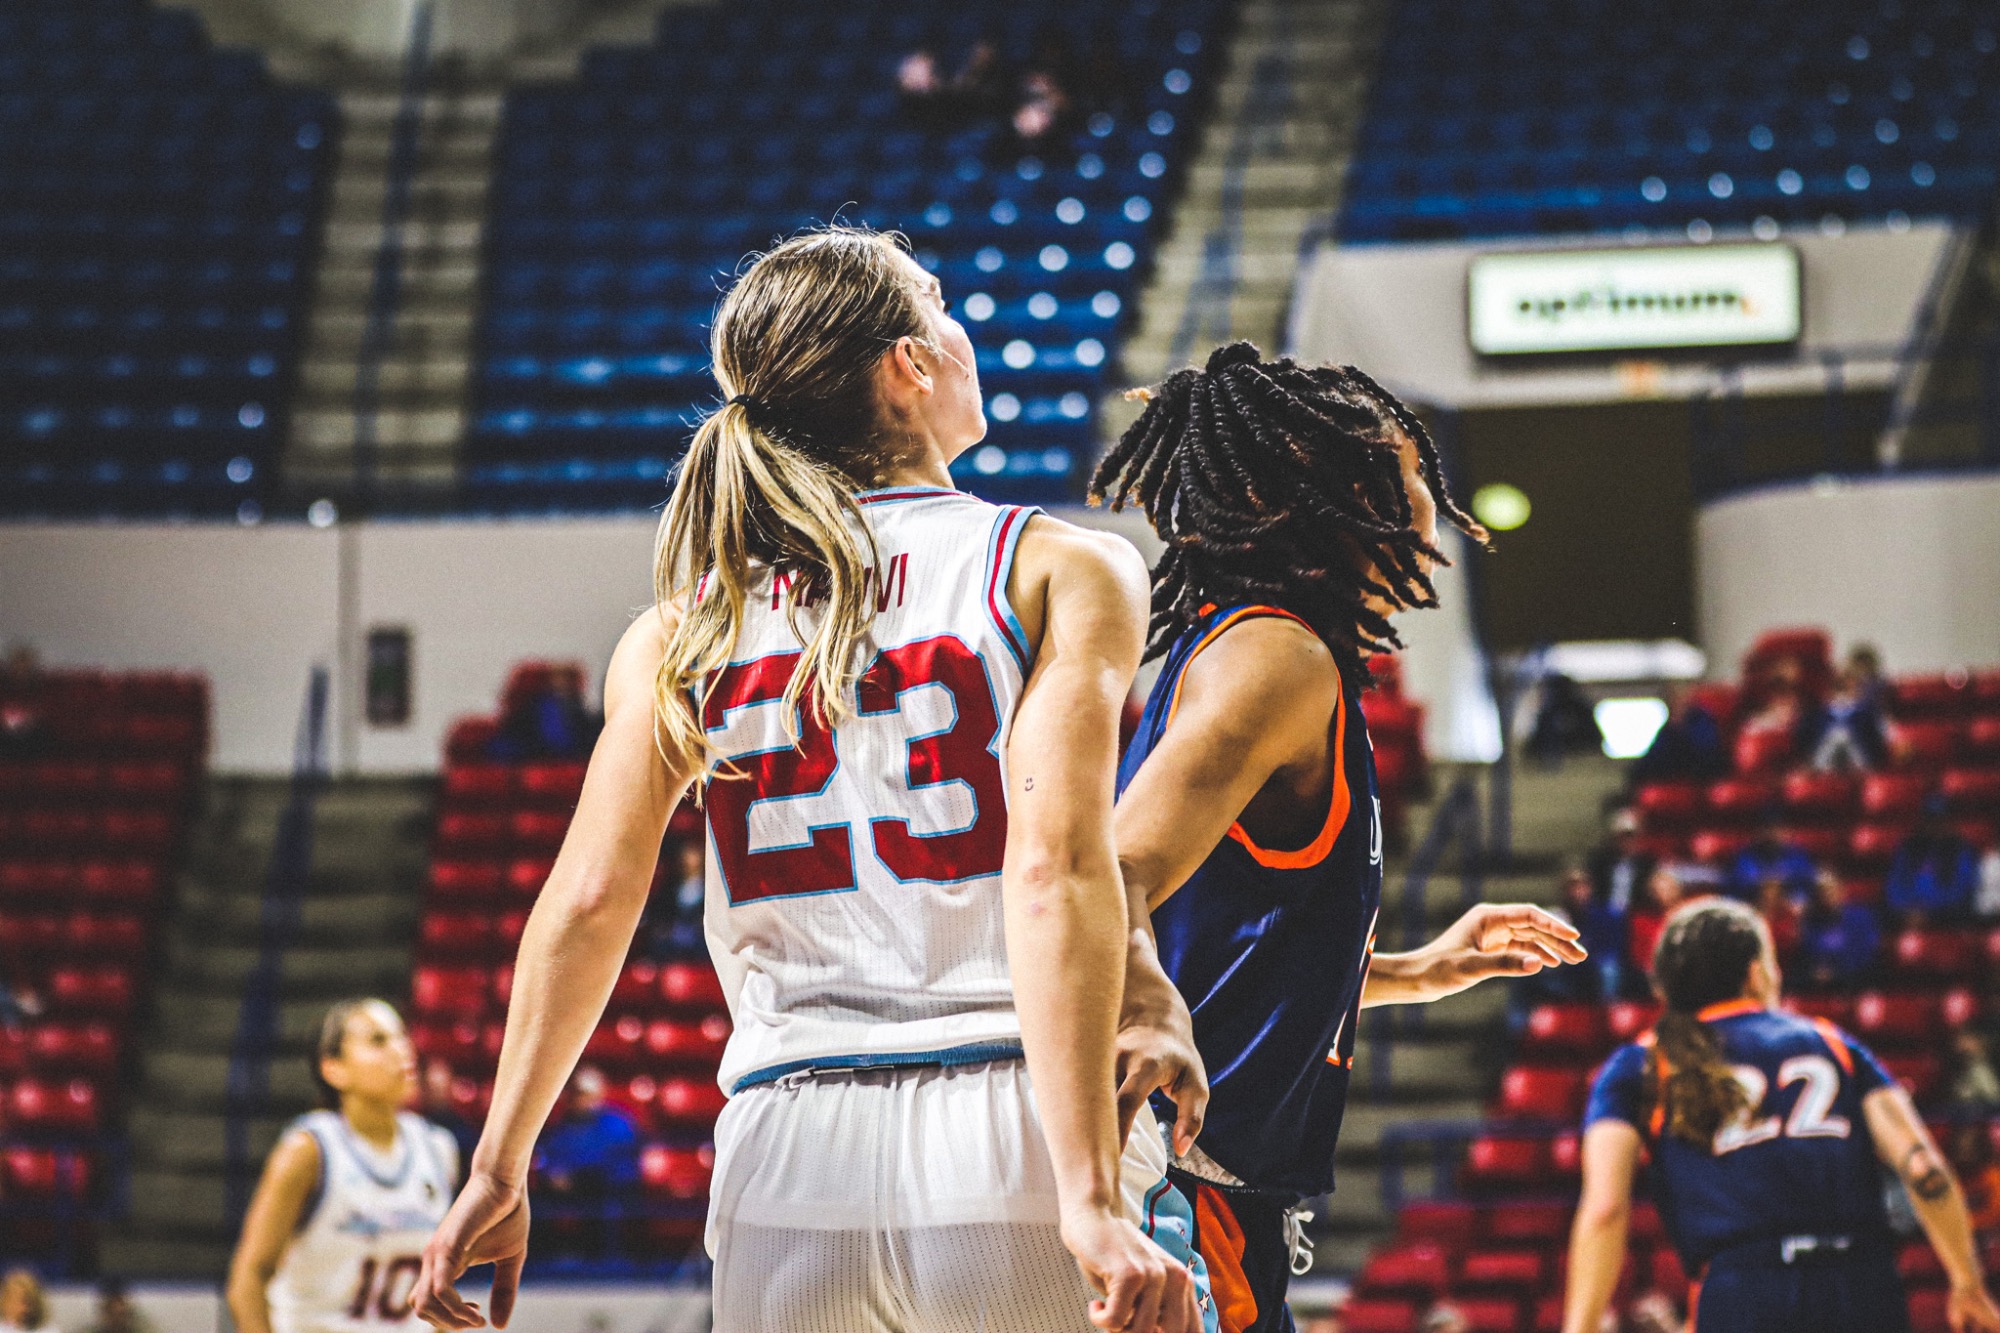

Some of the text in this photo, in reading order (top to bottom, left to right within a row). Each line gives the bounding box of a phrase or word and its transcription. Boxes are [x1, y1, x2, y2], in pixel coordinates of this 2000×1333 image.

[705, 632, 1009, 908] 23
[1711, 1054, 1851, 1156] 22
[348, 1255, 423, 1321] 10
